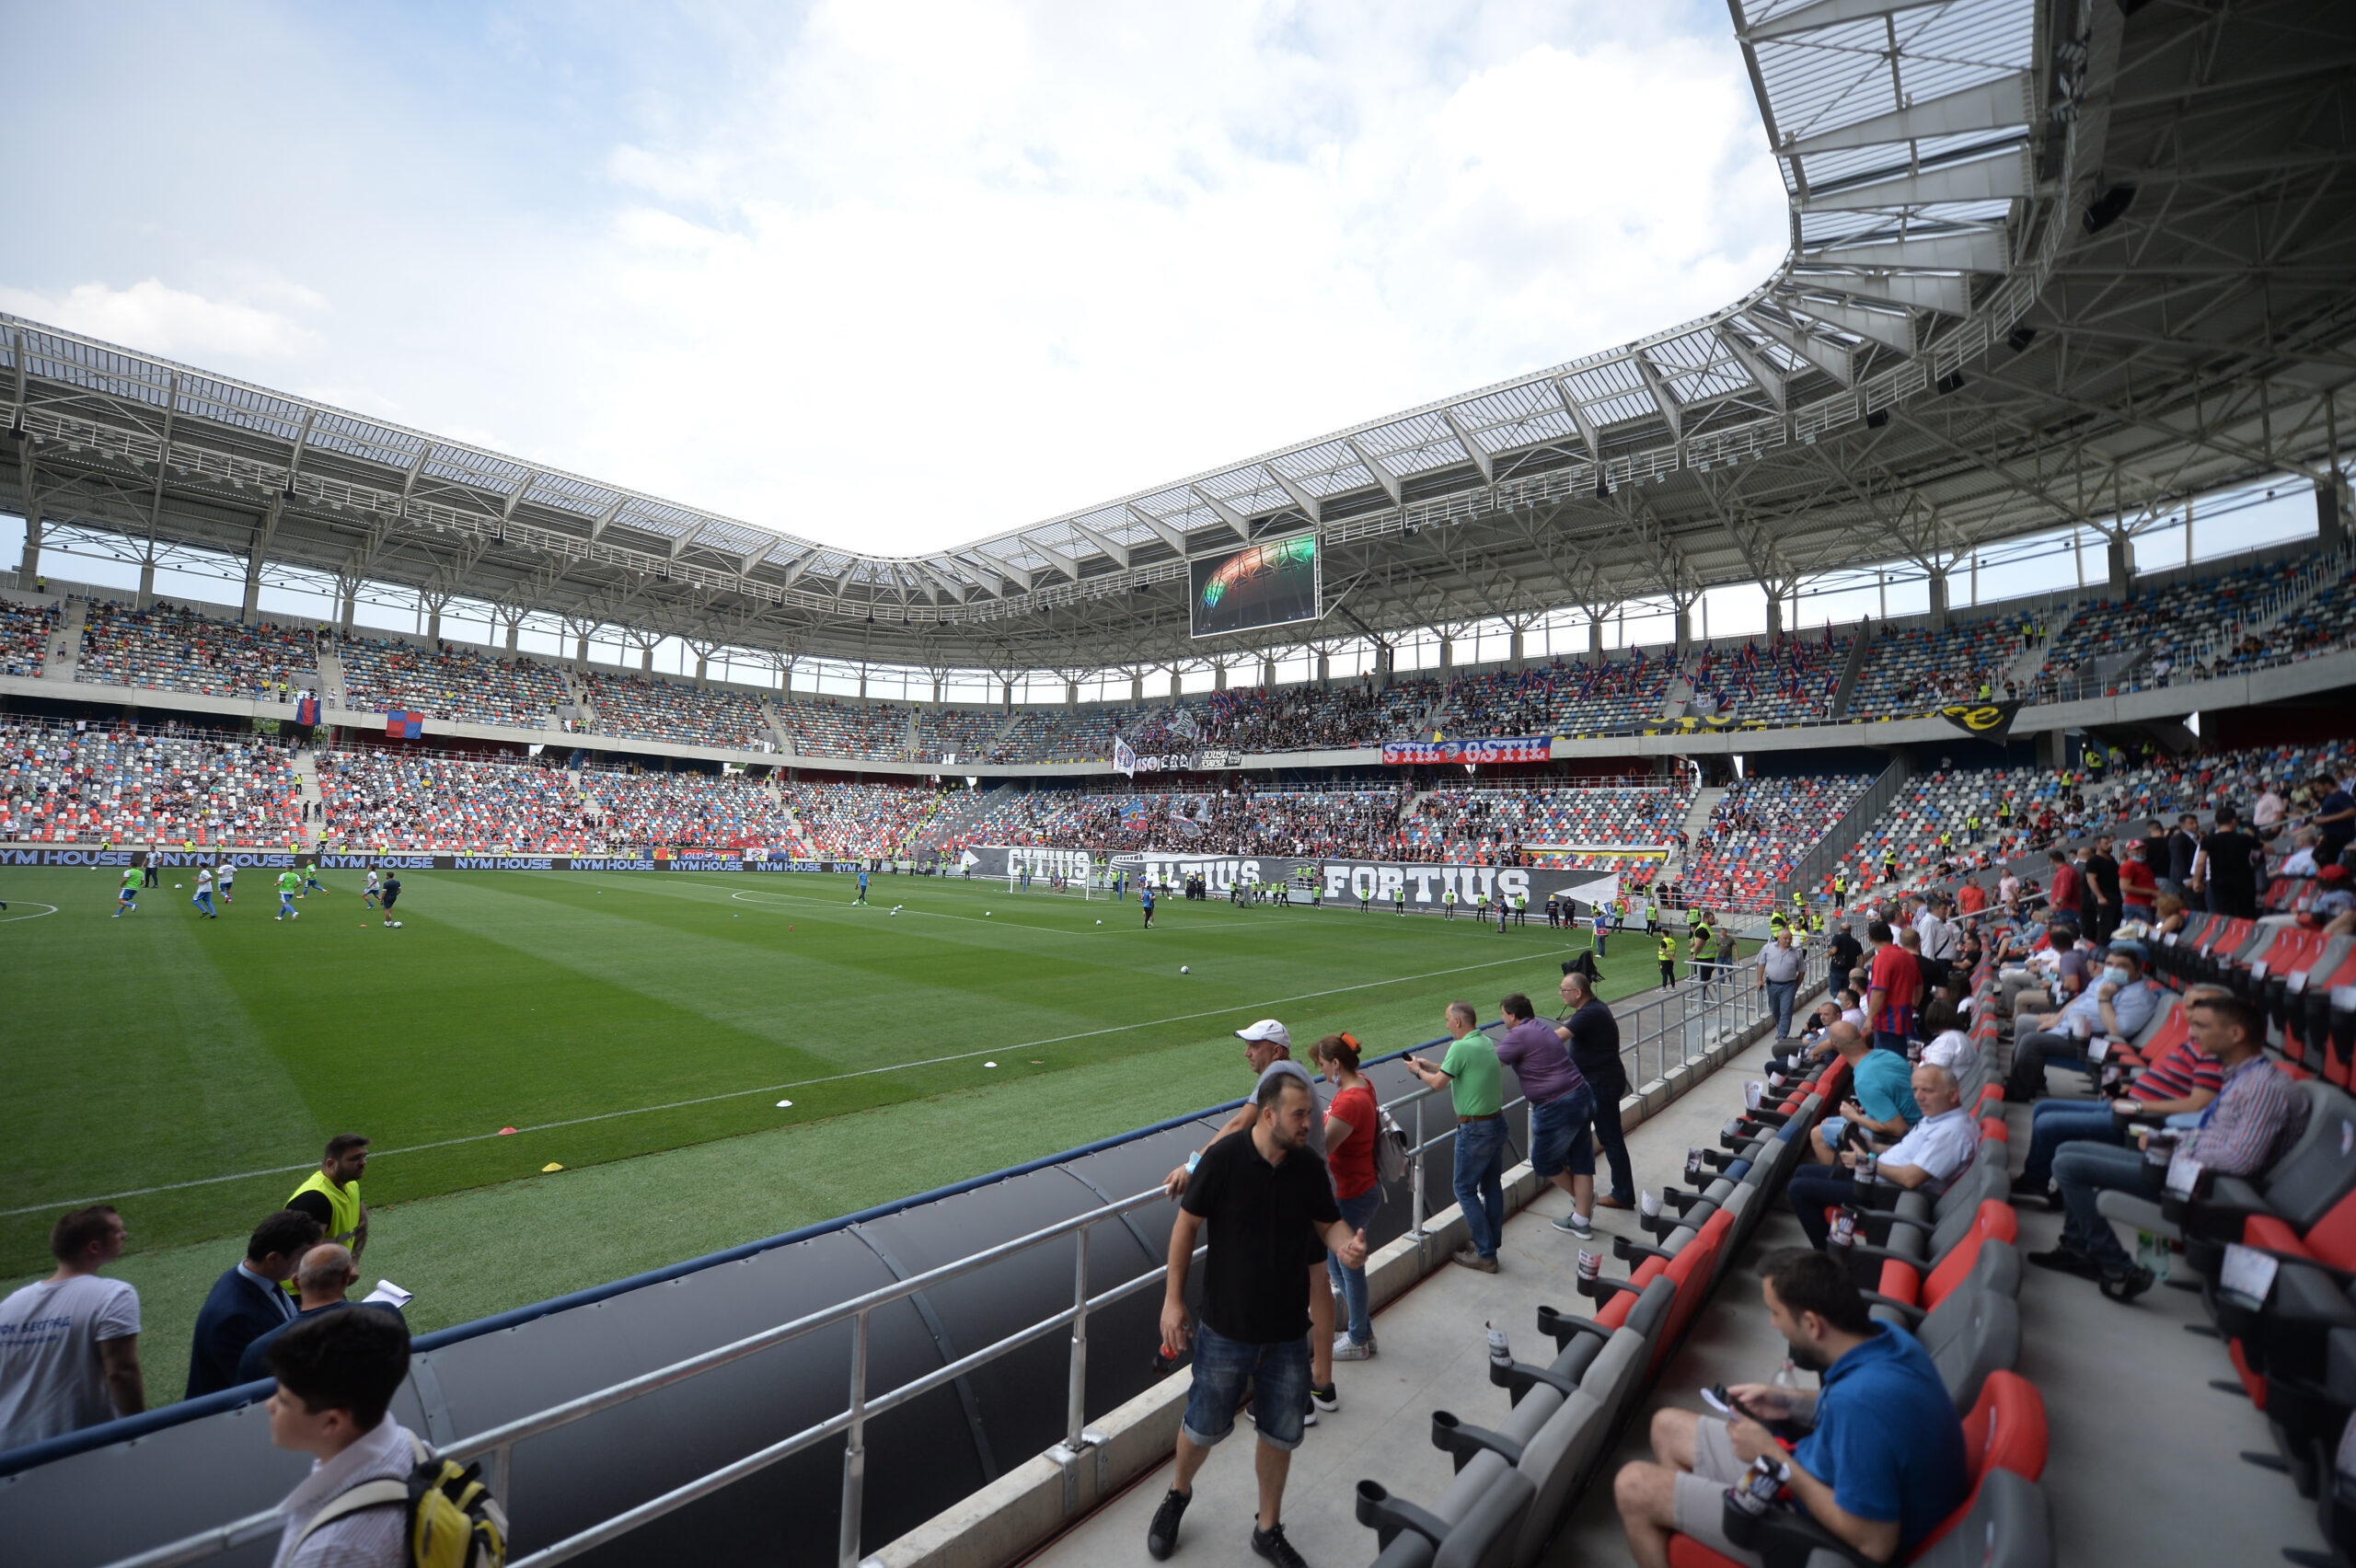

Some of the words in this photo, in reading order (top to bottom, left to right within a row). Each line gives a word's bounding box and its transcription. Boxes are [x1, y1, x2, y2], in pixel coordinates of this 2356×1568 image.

[1383, 743, 1439, 763] STIL
[1463, 738, 1546, 762] OSTIL
[0, 849, 39, 865] YM
[44, 850, 133, 866] HOUSE
[163, 852, 216, 866] NYM
[221, 853, 296, 868] HOUSE
[320, 855, 365, 869] NYM
[369, 856, 434, 869] HOUSE
[455, 857, 493, 870] NYM
[496, 858, 552, 870] HOUSE
[570, 859, 604, 870] NYM
[606, 859, 655, 870] HOUSE
[670, 860, 699, 871] NYM
[701, 860, 744, 871] HOUSE
[756, 862, 782, 871] NYM
[784, 862, 822, 872] HOUSE
[833, 863, 856, 872] NYM
[1323, 867, 1530, 907] FORTIUS
